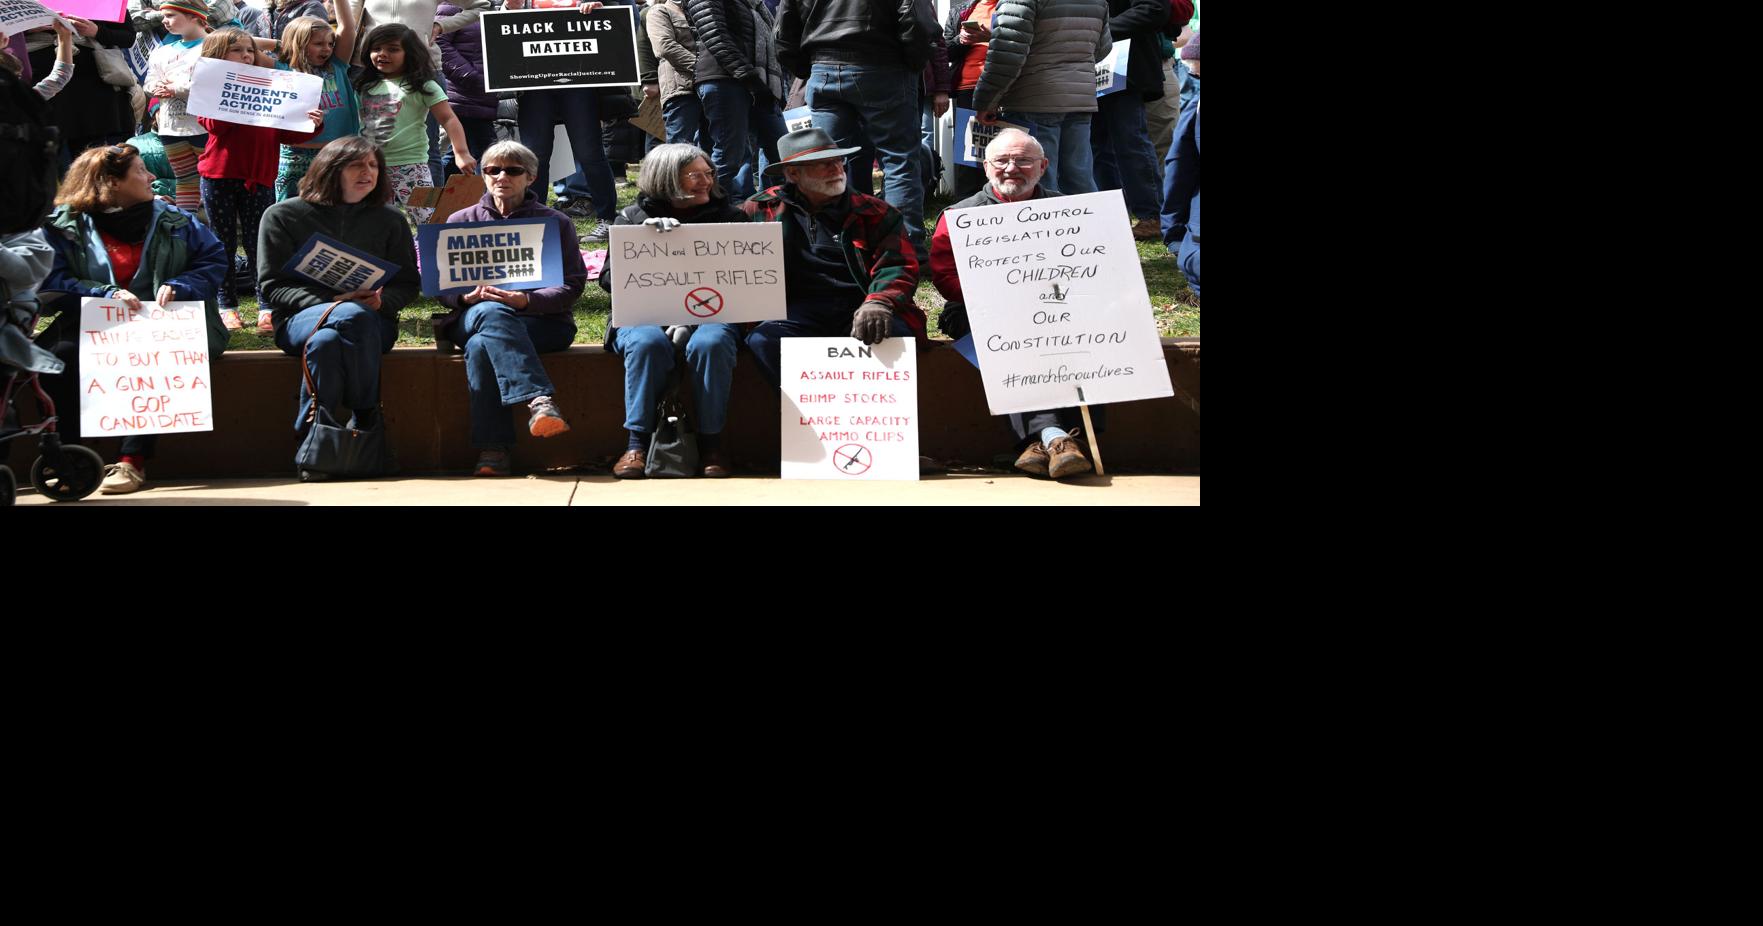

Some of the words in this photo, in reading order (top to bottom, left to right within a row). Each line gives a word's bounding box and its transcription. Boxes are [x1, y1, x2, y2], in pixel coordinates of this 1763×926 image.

[0, 9, 45, 22] ACTION
[501, 22, 554, 35] BLACK
[567, 20, 612, 32] LIVES
[530, 41, 592, 54] MATTER
[509, 71, 616, 80] ShowingUpForRacialJustice.org
[221, 91, 282, 105] DEMAND
[223, 82, 298, 99] STUDENTS
[219, 99, 273, 112] ACTION
[447, 232, 521, 250] MARCH
[965, 225, 1081, 248] LEGISLATION
[448, 250, 489, 266] FOR
[492, 247, 535, 263] OUR
[623, 241, 668, 260] BAN
[968, 252, 1046, 269] PROTECTS
[1061, 243, 1106, 257] OUR
[309, 248, 338, 272] LIVES
[330, 256, 357, 276] FOR
[449, 265, 507, 282] LIVES
[624, 271, 705, 289] ASSAULT
[715, 269, 778, 285] RIFLES
[1006, 264, 1098, 285] CHILDREN
[97, 306, 141, 322] THE
[1032, 310, 1071, 325] OUR
[987, 331, 1127, 352] CONSTITUTION
[90, 352, 118, 367] TO
[128, 351, 160, 367] BUY
[169, 351, 209, 366] THAN
[827, 346, 872, 358] BAN
[800, 370, 855, 380] ASSAULT
[862, 370, 910, 381] RIFLES
[1001, 364, 1134, 388] #marchforourlives
[87, 378, 106, 394] A
[116, 376, 155, 391] GUN
[164, 375, 185, 391] IS
[191, 376, 207, 389] A
[131, 395, 170, 413] GOP
[800, 393, 836, 403] BUMP
[844, 393, 897, 403] STOCKS
[99, 411, 205, 431] CANDIDATE
[800, 416, 840, 425] LARGE
[849, 416, 910, 426] CAPACITY
[819, 431, 859, 441] AMMO
[865, 431, 904, 442] CLIPS
